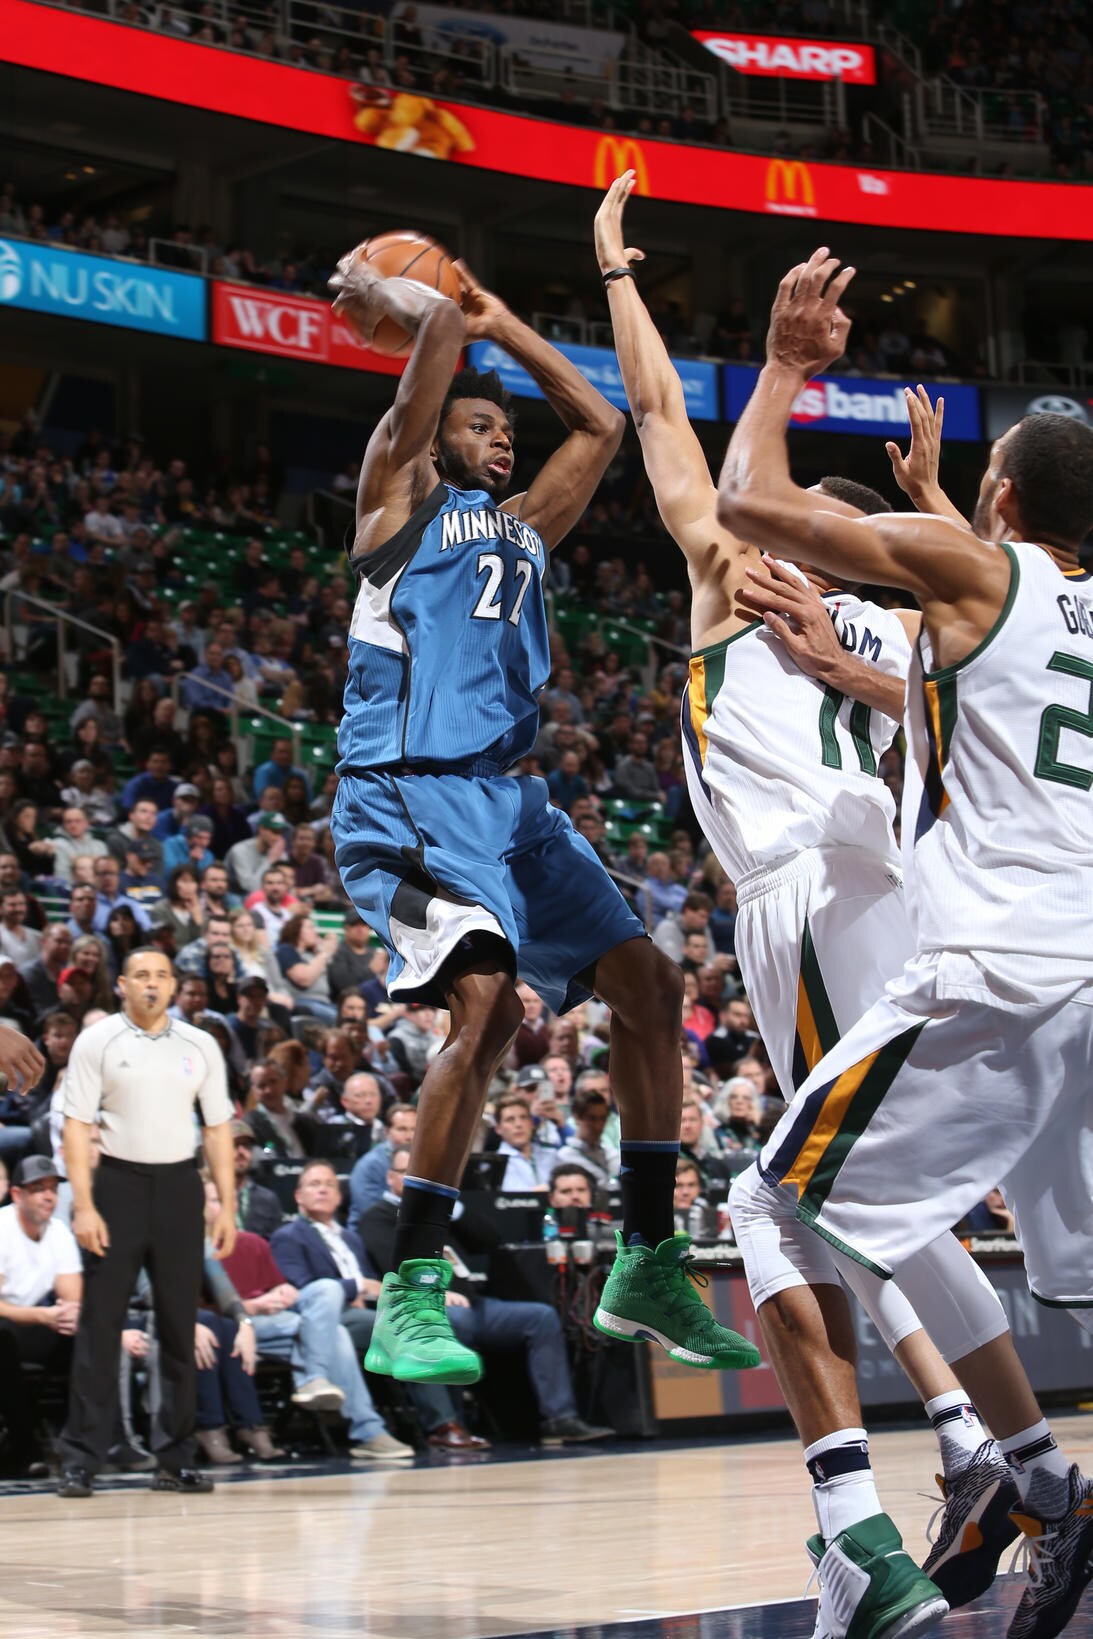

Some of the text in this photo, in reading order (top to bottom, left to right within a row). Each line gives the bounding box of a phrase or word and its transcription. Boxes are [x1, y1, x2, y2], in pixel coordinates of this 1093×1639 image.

[702, 38, 862, 76] SHARP
[229, 296, 322, 349] WCF
[439, 509, 541, 560] MINNESOT
[818, 678, 877, 777] 11
[1033, 651, 1093, 792] 2
